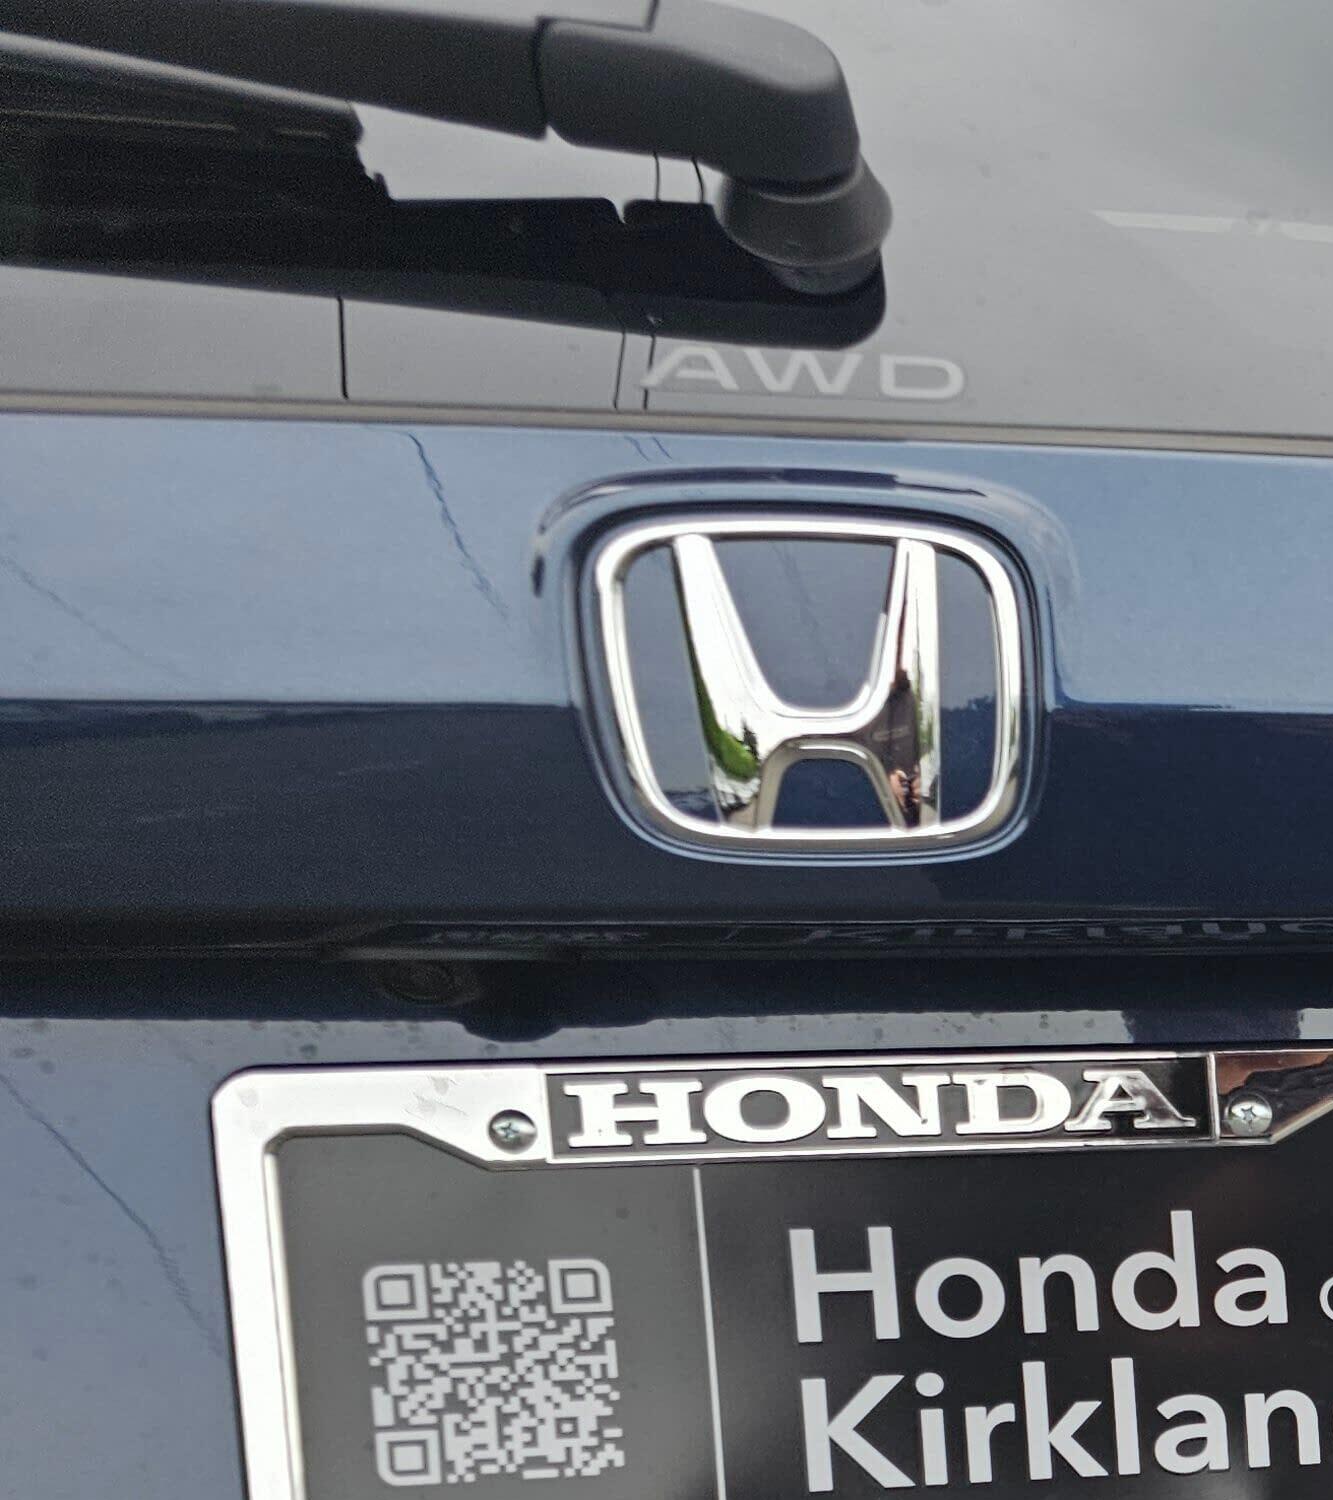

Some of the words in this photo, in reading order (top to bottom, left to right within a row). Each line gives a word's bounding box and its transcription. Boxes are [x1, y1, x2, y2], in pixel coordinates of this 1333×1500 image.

[641, 345, 965, 399] AWD
[565, 1069, 1196, 1148] HONDA
[790, 1210, 1289, 1343] Honda
